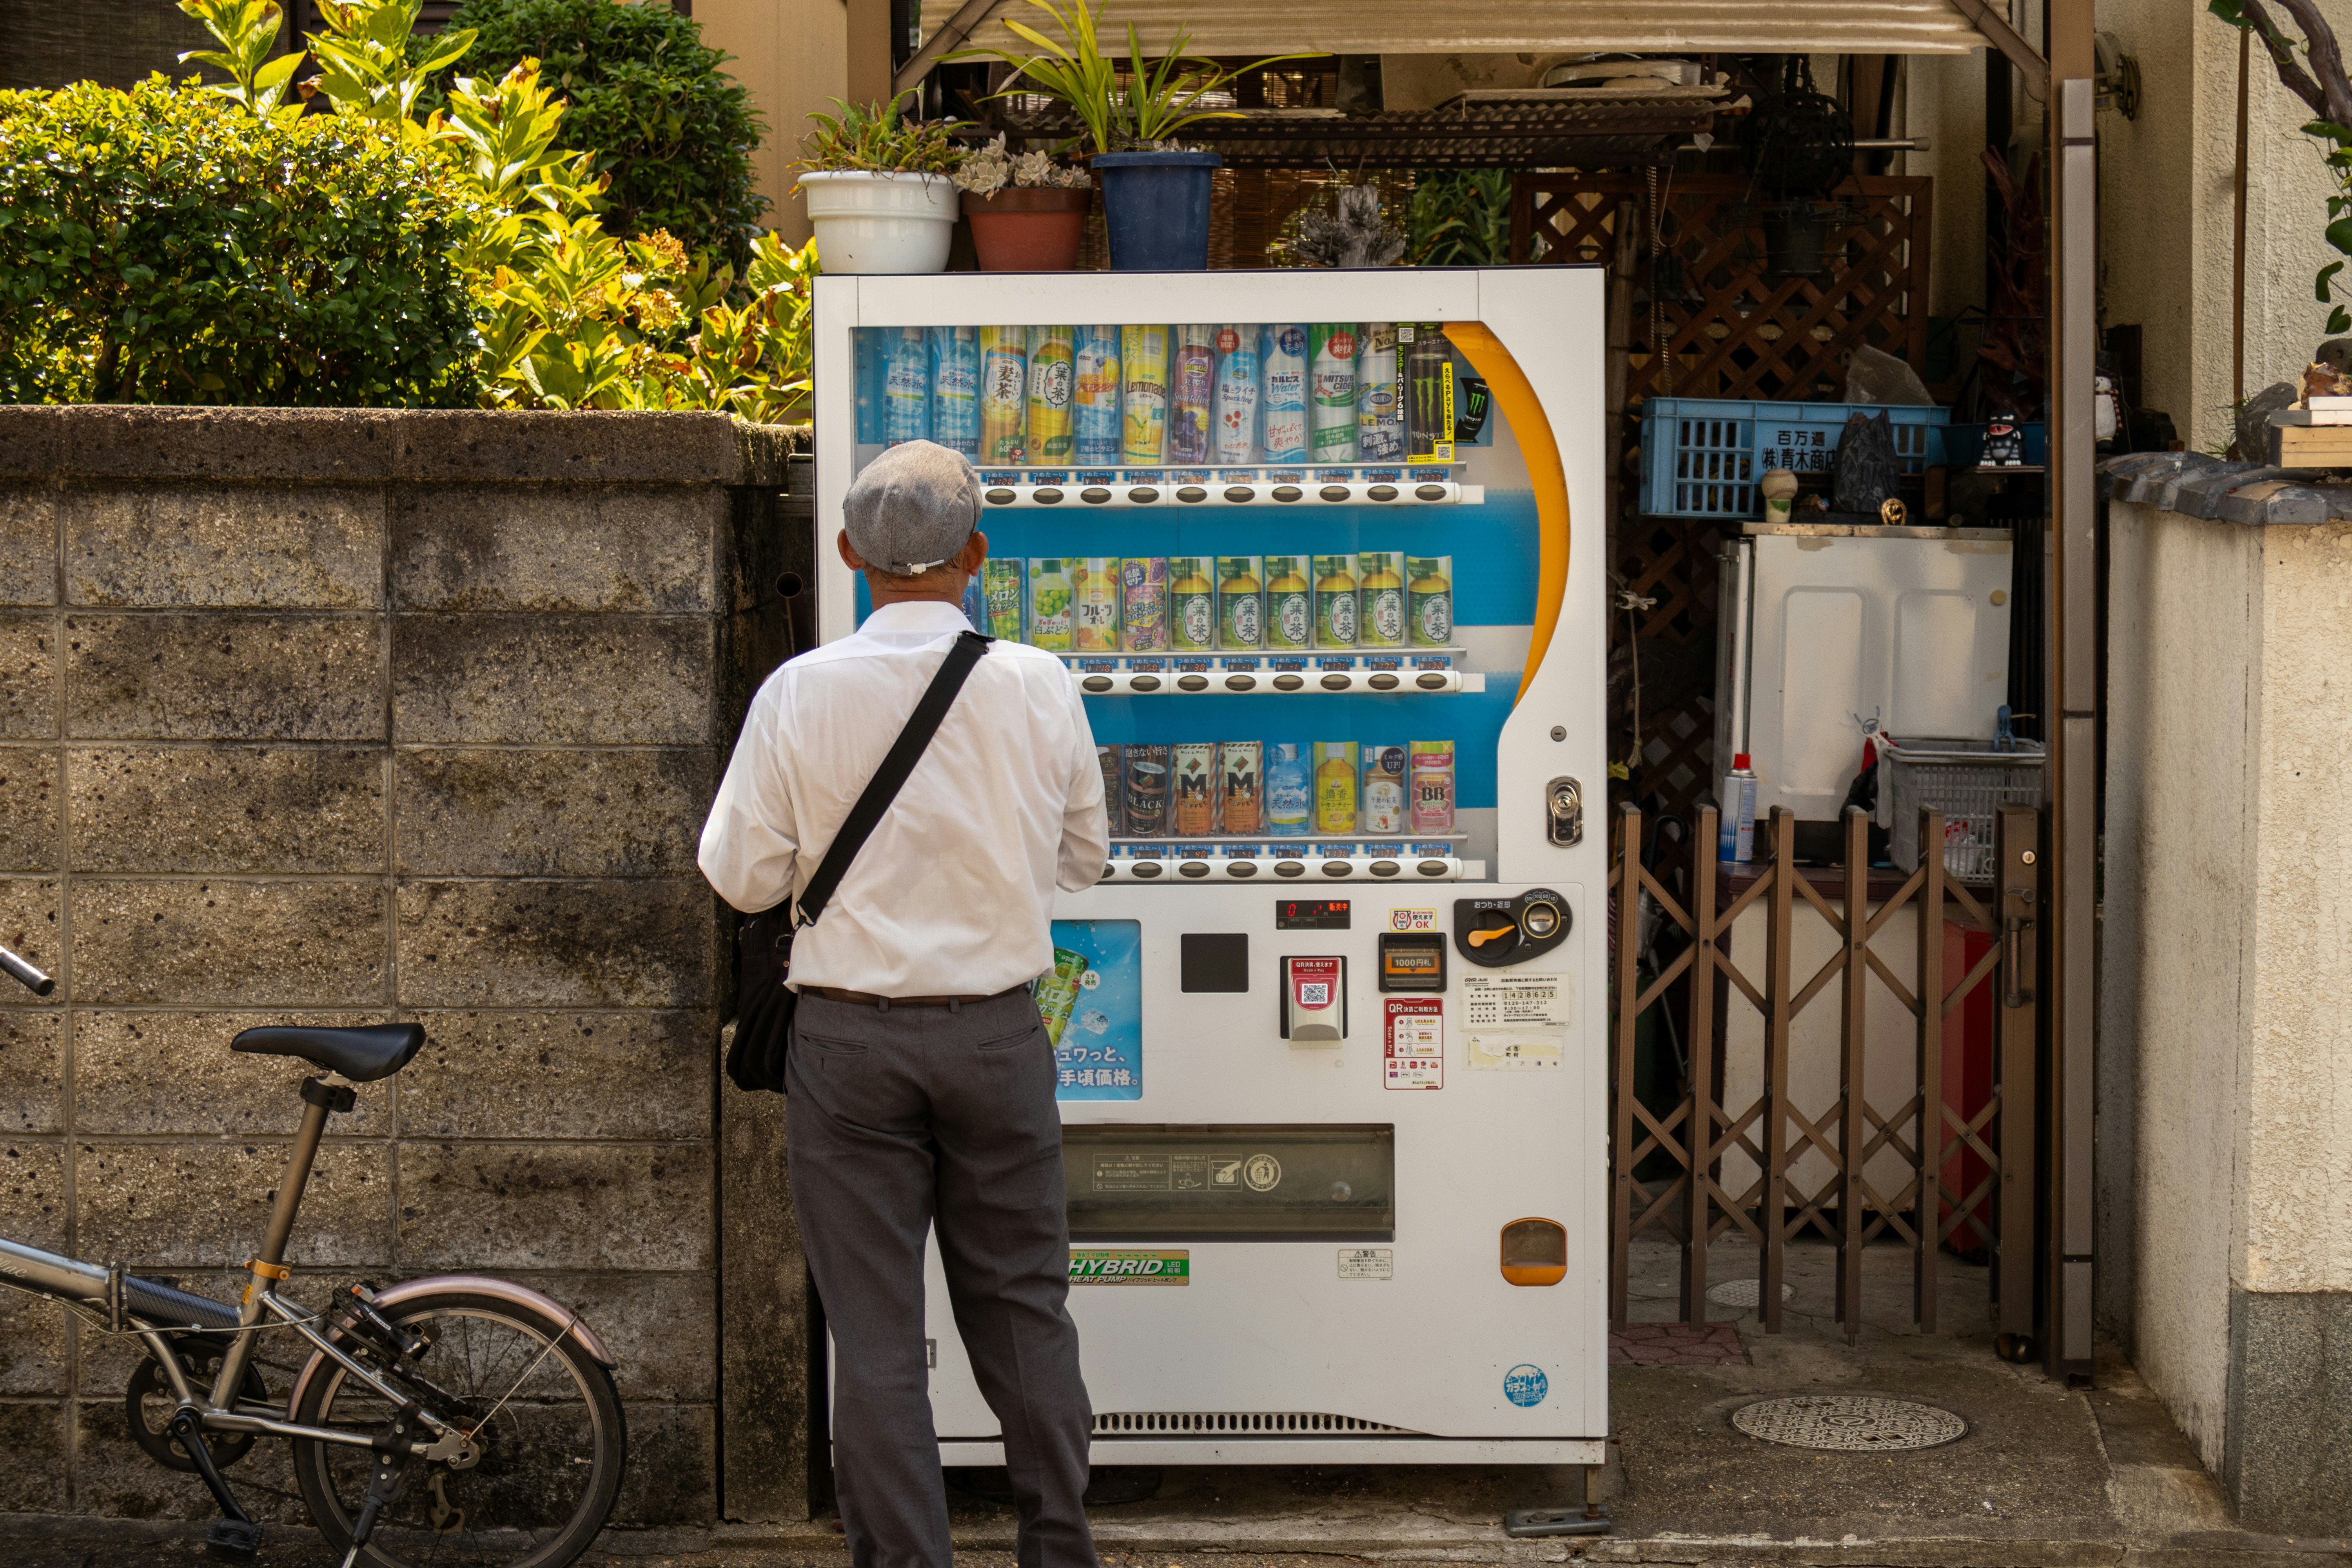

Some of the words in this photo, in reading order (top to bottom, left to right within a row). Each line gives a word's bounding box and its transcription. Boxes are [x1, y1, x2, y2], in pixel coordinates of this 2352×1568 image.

[1285, 333, 1301, 343] 後味
[1283, 342, 1304, 352] すっきり
[1333, 344, 1352, 354] 爽快
[1185, 364, 1208, 373] mistio
[889, 375, 923, 389] 天然水
[940, 375, 974, 389] 天然水
[994, 365, 1014, 399] 麦茶
[1011, 371, 1021, 396] おいしい
[1184, 377, 1206, 387] 丸搾り
[1323, 374, 1354, 383] MITSUYA
[1085, 383, 1114, 392] オレンジ
[1126, 380, 1166, 399] Lemonade
[1221, 383, 1256, 396] 塩とライチ
[1270, 383, 1301, 394] Water
[1174, 392, 1210, 407] Sparkling
[1222, 394, 1253, 405] Sparkling
[1370, 394, 1392, 403] WILKINSON
[1268, 423, 1305, 438] 甘ずっぱくて、
[1274, 433, 1303, 449] 爽やか
[1362, 433, 1387, 448] 刺激、
[1377, 443, 1401, 456] 強め。
[1124, 568, 1141, 579] 炭酸
[1126, 577, 1143, 586] ゼリー
[988, 589, 1020, 604] メロン
[988, 601, 1020, 612] スカッシュ
[1082, 604, 1112, 617] フルーツ
[1126, 601, 1165, 622] スパークリング
[1289, 601, 1303, 636] 葉の茶
[1339, 600, 1352, 636] 葉の茶
[1383, 597, 1397, 633] 葉の茶
[1431, 601, 1446, 636] 葉の茶
[1034, 624, 1070, 635] 白ぶどう
[1125, 746, 1168, 757] 飽きない旨さ
[1325, 788, 1348, 799] 濃香
[1422, 787, 1445, 801] BB
[1127, 792, 1163, 809] BLACK
[1180, 800, 1208, 809] COFFEE
[1228, 798, 1255, 807] COFFEE
[1271, 799, 1307, 809] 天然水
[1371, 796, 1398, 804] 午後の紅茶
[1328, 902, 1348, 911] 販売中
[1395, 959, 1431, 967] 1000円札
[1389, 1004, 1438, 1014] QR決済ご利用方法
[1059, 1069, 1138, 1087] 手頃価格。
[1249, 1157, 1276, 1168] のんだあとは
[1250, 1180, 1275, 1189] リサイクル
[1069, 1259, 1164, 1275] HYBRID
